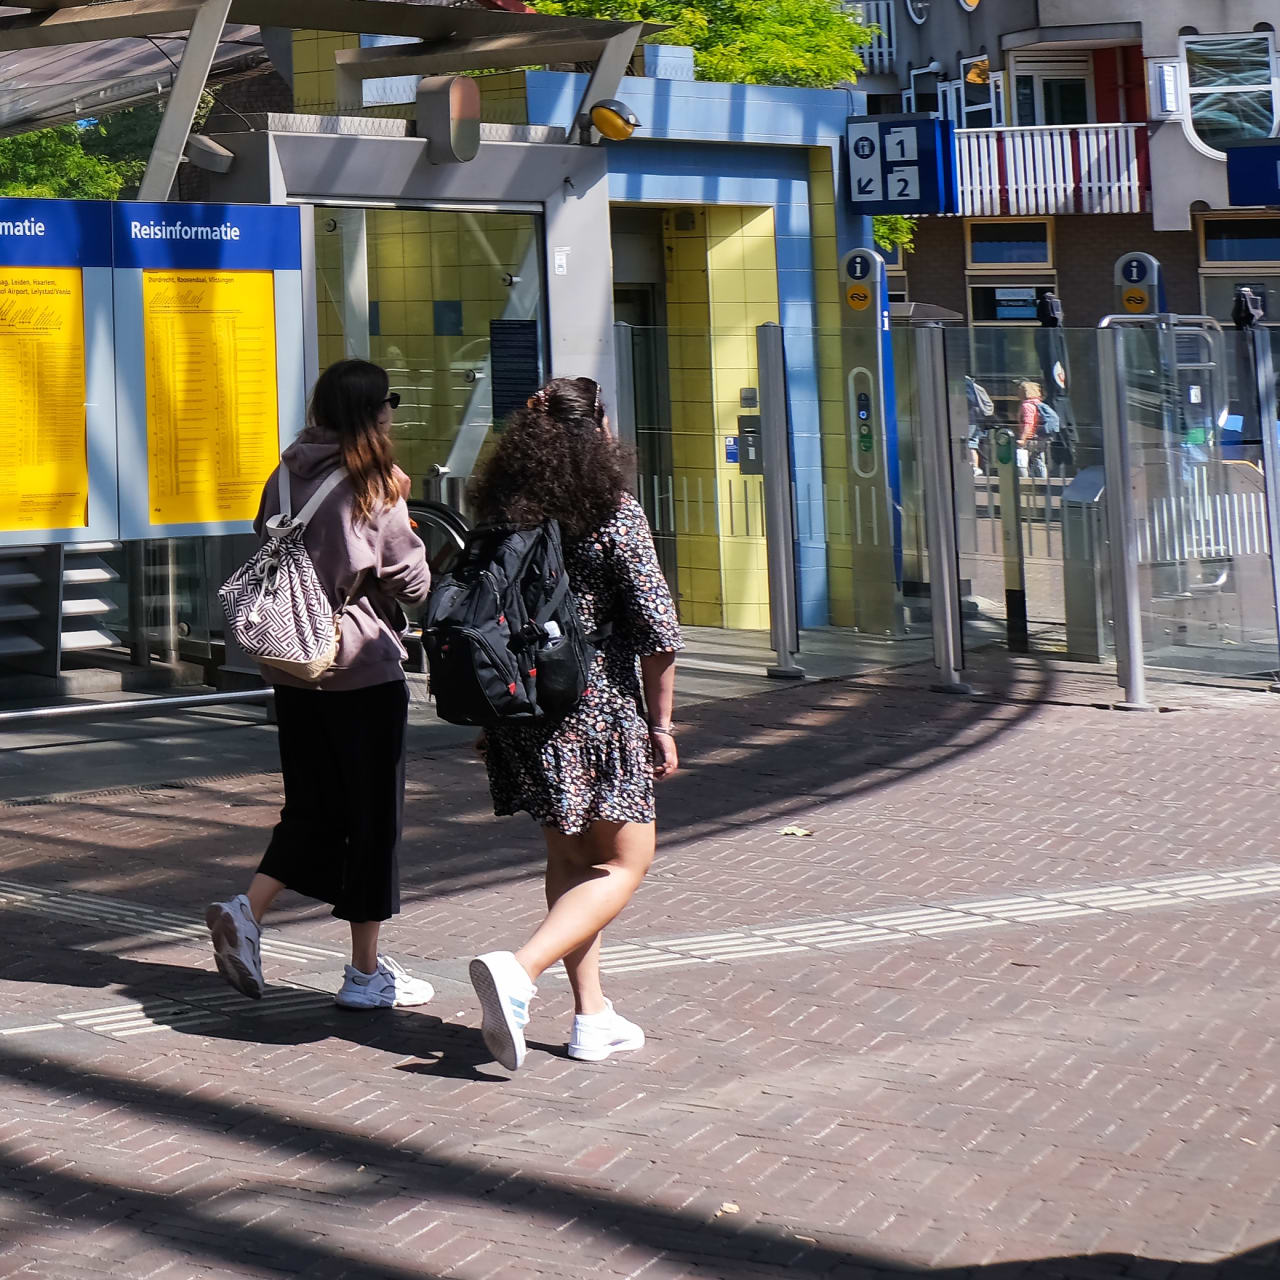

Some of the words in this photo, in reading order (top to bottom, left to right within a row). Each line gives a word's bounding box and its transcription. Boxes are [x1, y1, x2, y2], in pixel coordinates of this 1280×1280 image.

[896, 139, 905, 158] 1
[897, 178, 909, 197] 2
[131, 221, 241, 241] Reisinformatie
